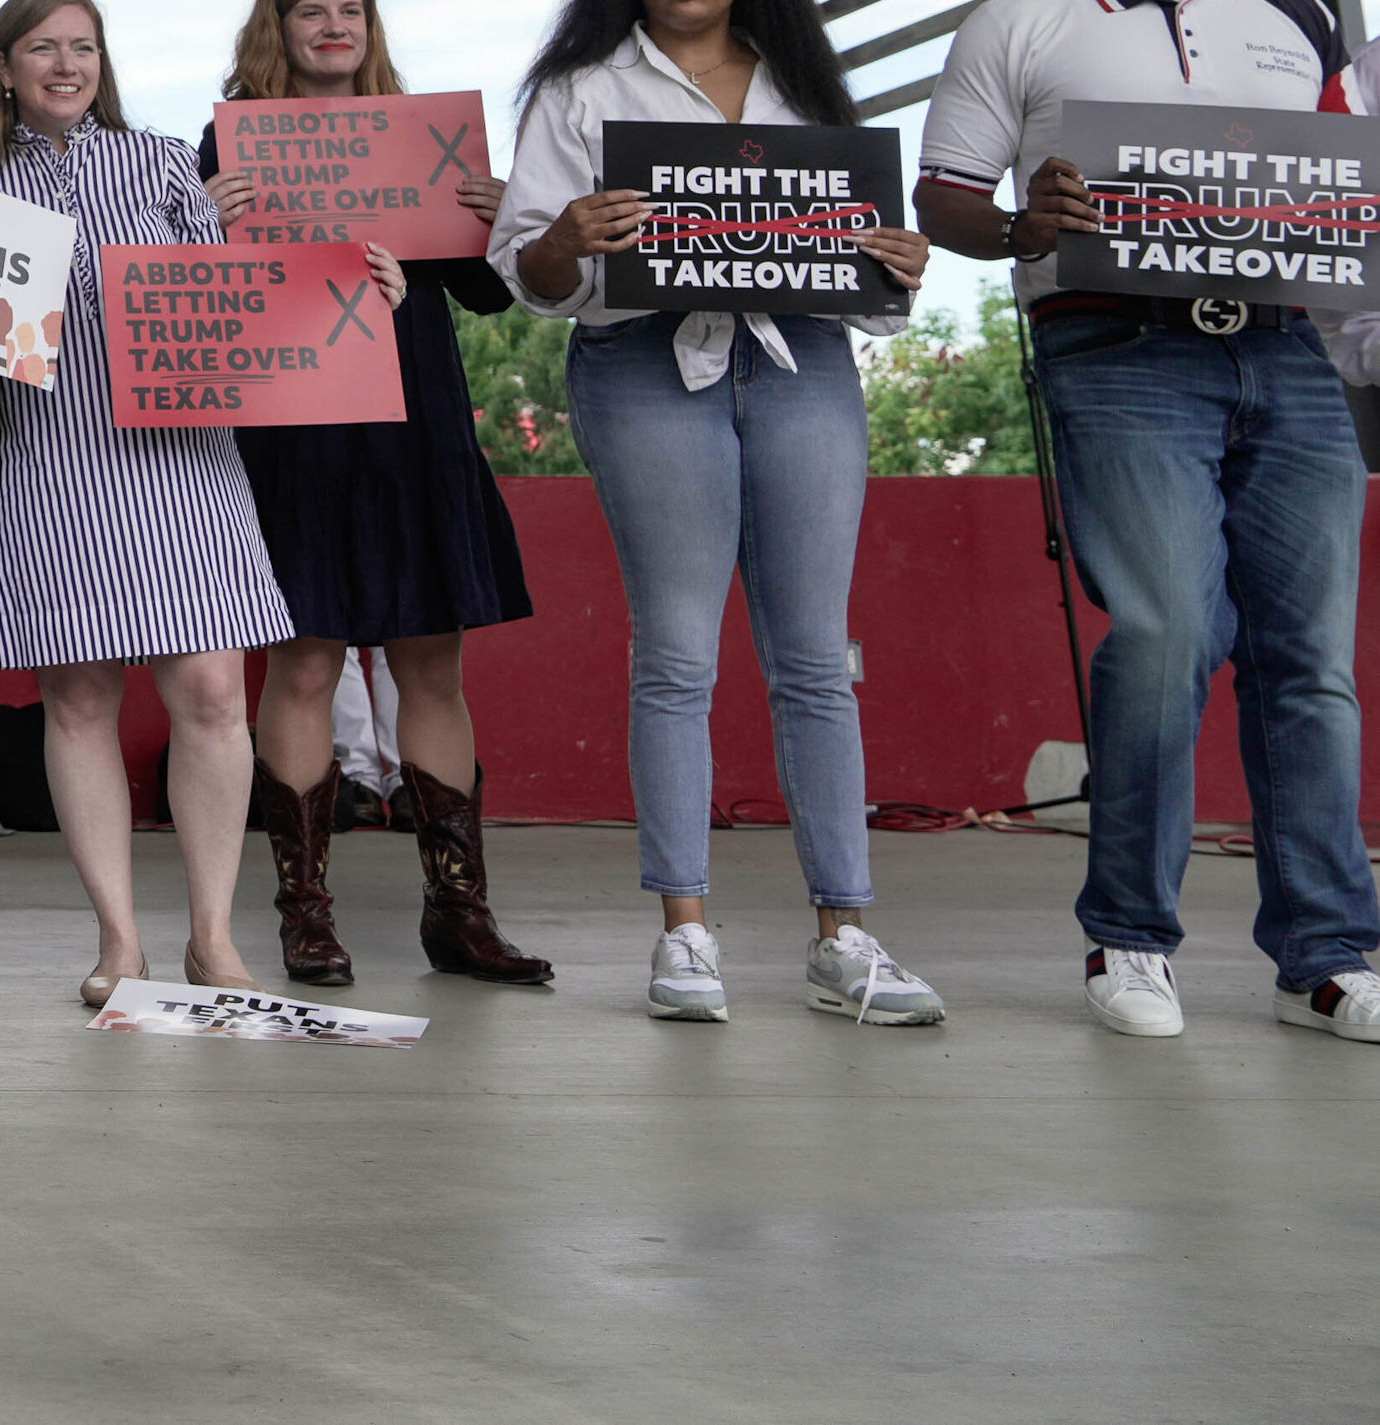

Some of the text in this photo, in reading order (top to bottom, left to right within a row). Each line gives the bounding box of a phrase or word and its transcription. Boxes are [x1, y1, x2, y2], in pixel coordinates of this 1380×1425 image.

[235, 110, 390, 137] ABBOTT'S
[236, 138, 370, 162] LETTING
[239, 164, 350, 187] TRUMP
[1118, 145, 1362, 188] FIGHT THE
[651, 166, 851, 198] FIGHT THE
[335, 187, 422, 211] OVER
[1084, 179, 1380, 248] TRUMP
[245, 224, 350, 244] TEXAS
[638, 202, 881, 254] TRUMP
[123, 261, 286, 285] ABBOTT'S
[648, 259, 860, 291] TAKEOVER
[1109, 239, 1365, 286] TAKEOVER
[125, 290, 265, 314] LETTING
[126, 319, 244, 343] TRUMP
[128, 347, 320, 372] TAKE OVER
[131, 386, 243, 410] TEXAS
[156, 1000, 370, 1032] TEXANS
[215, 993, 320, 1018] PUT
